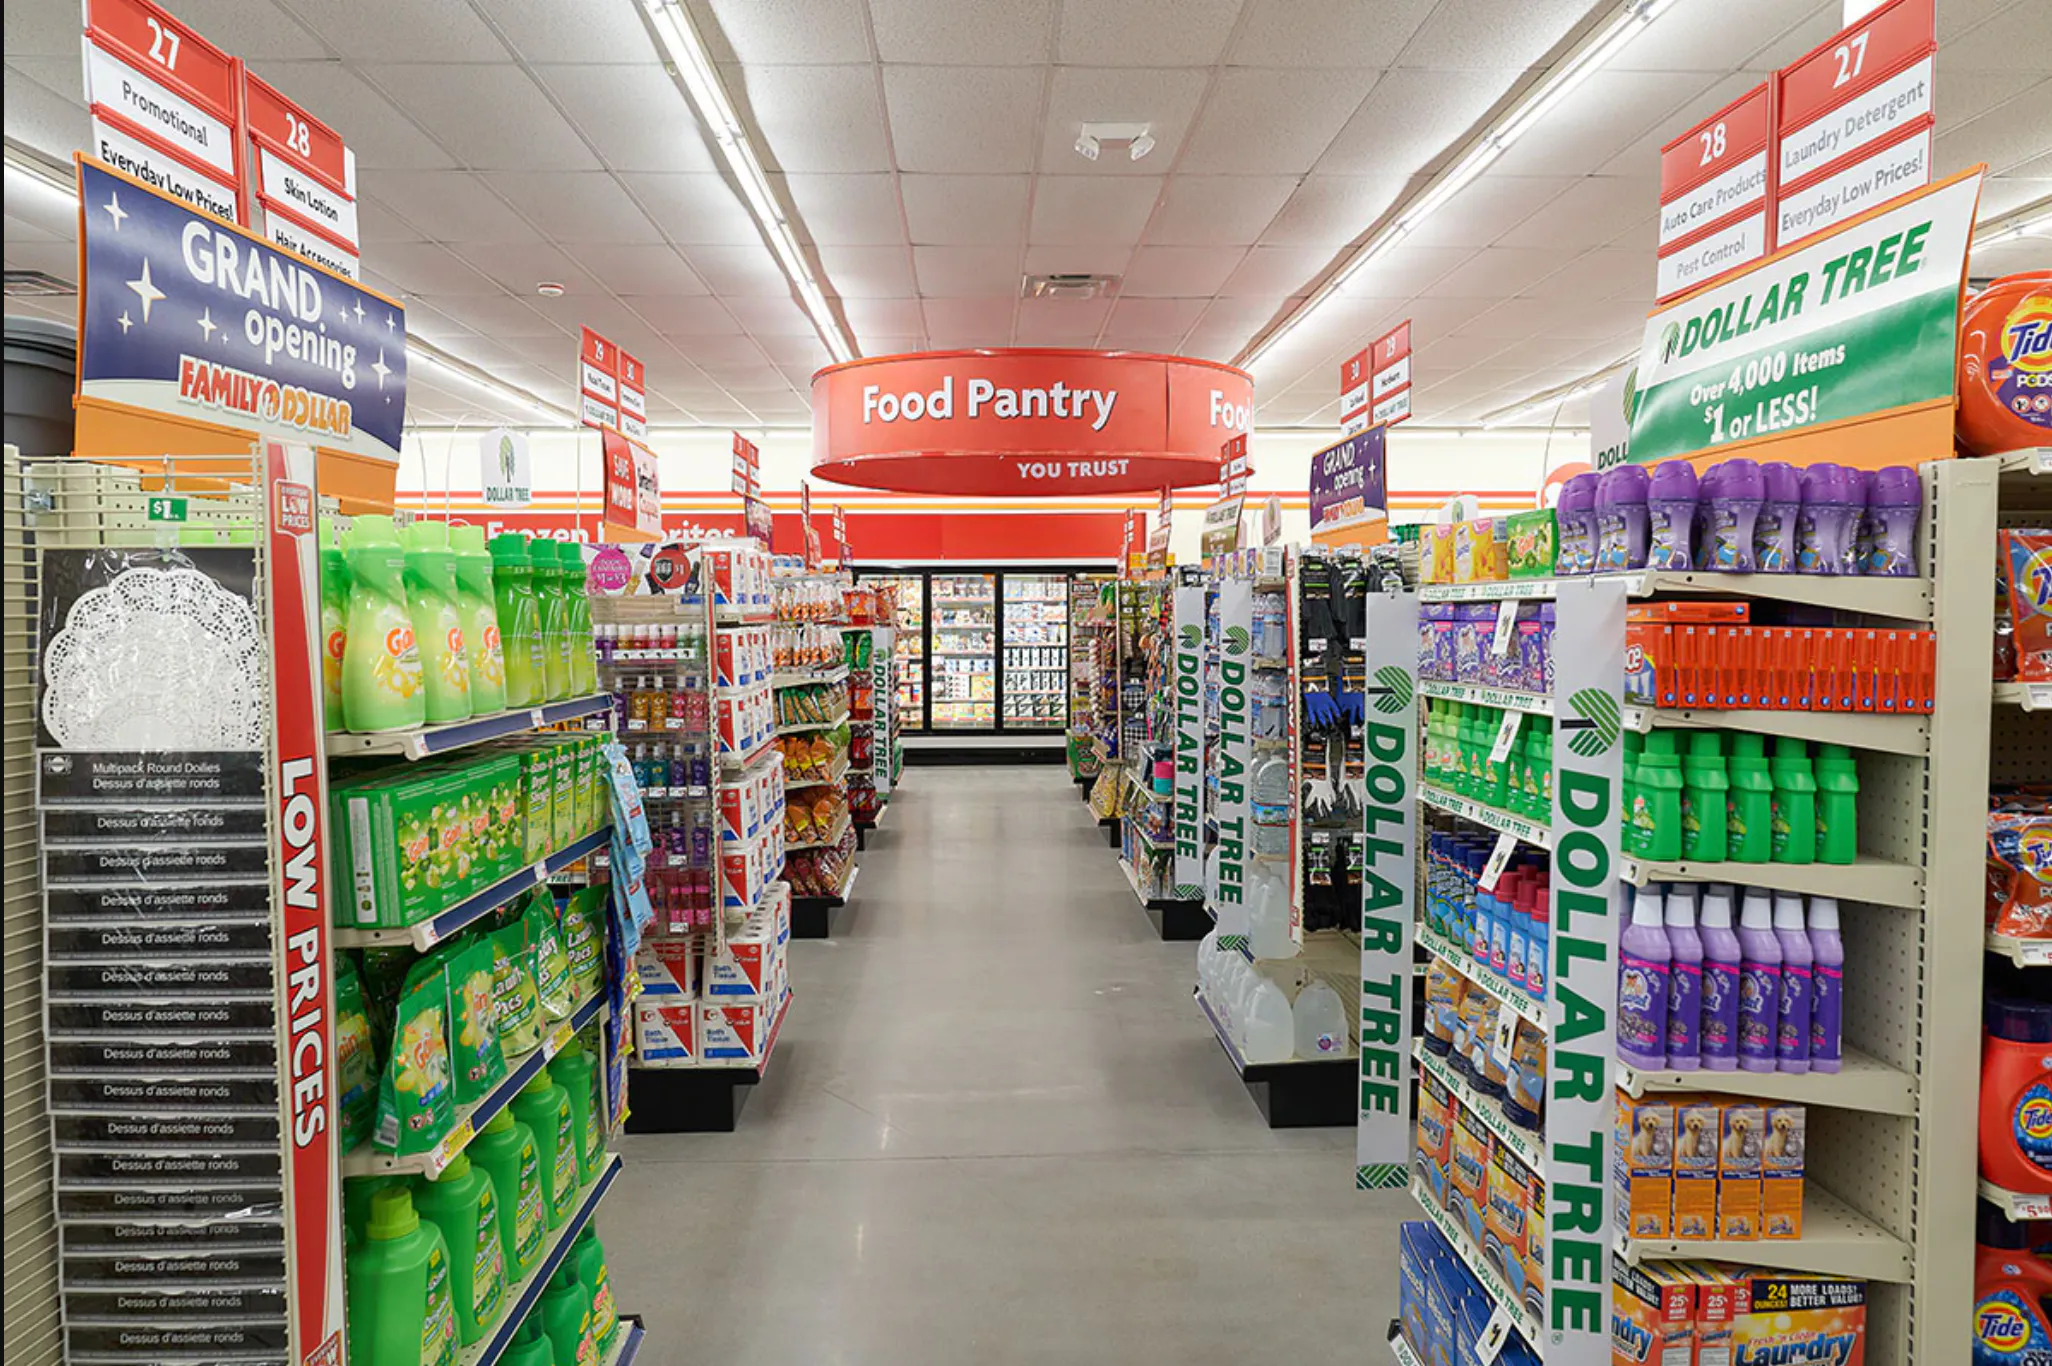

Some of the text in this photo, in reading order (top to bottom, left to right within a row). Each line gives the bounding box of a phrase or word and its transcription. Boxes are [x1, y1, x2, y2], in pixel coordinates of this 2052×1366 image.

[147, 17, 180, 71] 27
[1832, 31, 1870, 90] 27
[122, 80, 208, 147] Promotional
[285, 112, 311, 158] 28
[1785, 80, 1924, 169] Laundry Detergent
[1699, 122, 1727, 167] 28
[100, 140, 235, 223] Everyday Low Prices!
[284, 177, 339, 223] Skin Lotion
[1662, 167, 1767, 233] Auto Care Products
[1781, 148, 1924, 232] Everyday Low Prices!
[275, 229, 298, 252] Hair
[1676, 233, 1746, 279] Pest Control
[181, 220, 322, 323] GRAND
[1679, 220, 1934, 359] DOLLAR TREE
[244, 309, 357, 390] opening
[2008, 320, 2052, 364] Tid
[179, 357, 351, 437] FAMILY DOLLAR
[1690, 344, 1846, 408] Over 4,000 Items
[861, 376, 1118, 431] Food Pantry
[1703, 385, 1818, 445] $1 or LESS!
[1017, 458, 1130, 479] YOU TRUST
[1323, 442, 1355, 477] GRAND
[1597, 441, 1629, 470] DOLL
[486, 486, 513, 502] DOLLAR
[487, 520, 588, 543] Frozen
[1485, 685, 1534, 709] DOLLAR TREE
[93, 762, 220, 774] Multipack Round Doilies
[1176, 654, 1199, 860] DOLLAR TREE
[93, 777, 220, 789] Dessus d'assiette ronds
[1218, 660, 1246, 905] DOLLAR TREE
[1426, 789, 1464, 813] DOLLAR TREE
[1483, 806, 1532, 837] DOLLAR TREE
[1361, 721, 1406, 1115] DOLLAR TREE
[281, 755, 327, 1148] LOW PRICES
[1422, 928, 1462, 969] DOLLAR TREE
[1480, 968, 1529, 1012] DOLLAR TREE
[103, 1009, 143, 1021] Dessus
[198, 1008, 229, 1020] ronds
[104, 1047, 231, 1059] Dessus d'assiette ronds
[1422, 1049, 1460, 1092] DOLLAR TREE
[1551, 767, 1611, 1334] DOLLAR TREE
[104, 1084, 230, 1097] Dessus d'assiette ronds
[108, 1122, 234, 1134] Dessus d'assiette ronds
[1480, 1104, 1506, 1137] DOLLAR
[1509, 1131, 1526, 1155] TREE
[112, 1158, 239, 1171] Dessus d'assiette ronds
[1421, 1196, 1459, 1244] DOLLAR TREE
[115, 1260, 155, 1272] Dessus
[209, 1259, 239, 1271] ronds
[118, 1296, 157, 1308] Dessus
[211, 1295, 242, 1307] ronds
[1477, 1262, 1523, 1325] DOLLAR TREE
[1768, 1284, 1788, 1300] 24
[1790, 1284, 1858, 1295] MORE LOADS!
[1790, 1293, 1863, 1307] BETTER VALUE!
[120, 1332, 160, 1344] Dessus
[214, 1331, 244, 1343] ronds
[1612, 1313, 1653, 1361] ndry
[1979, 1312, 2025, 1340] Tide
[1735, 1332, 1857, 1366] Laundry
